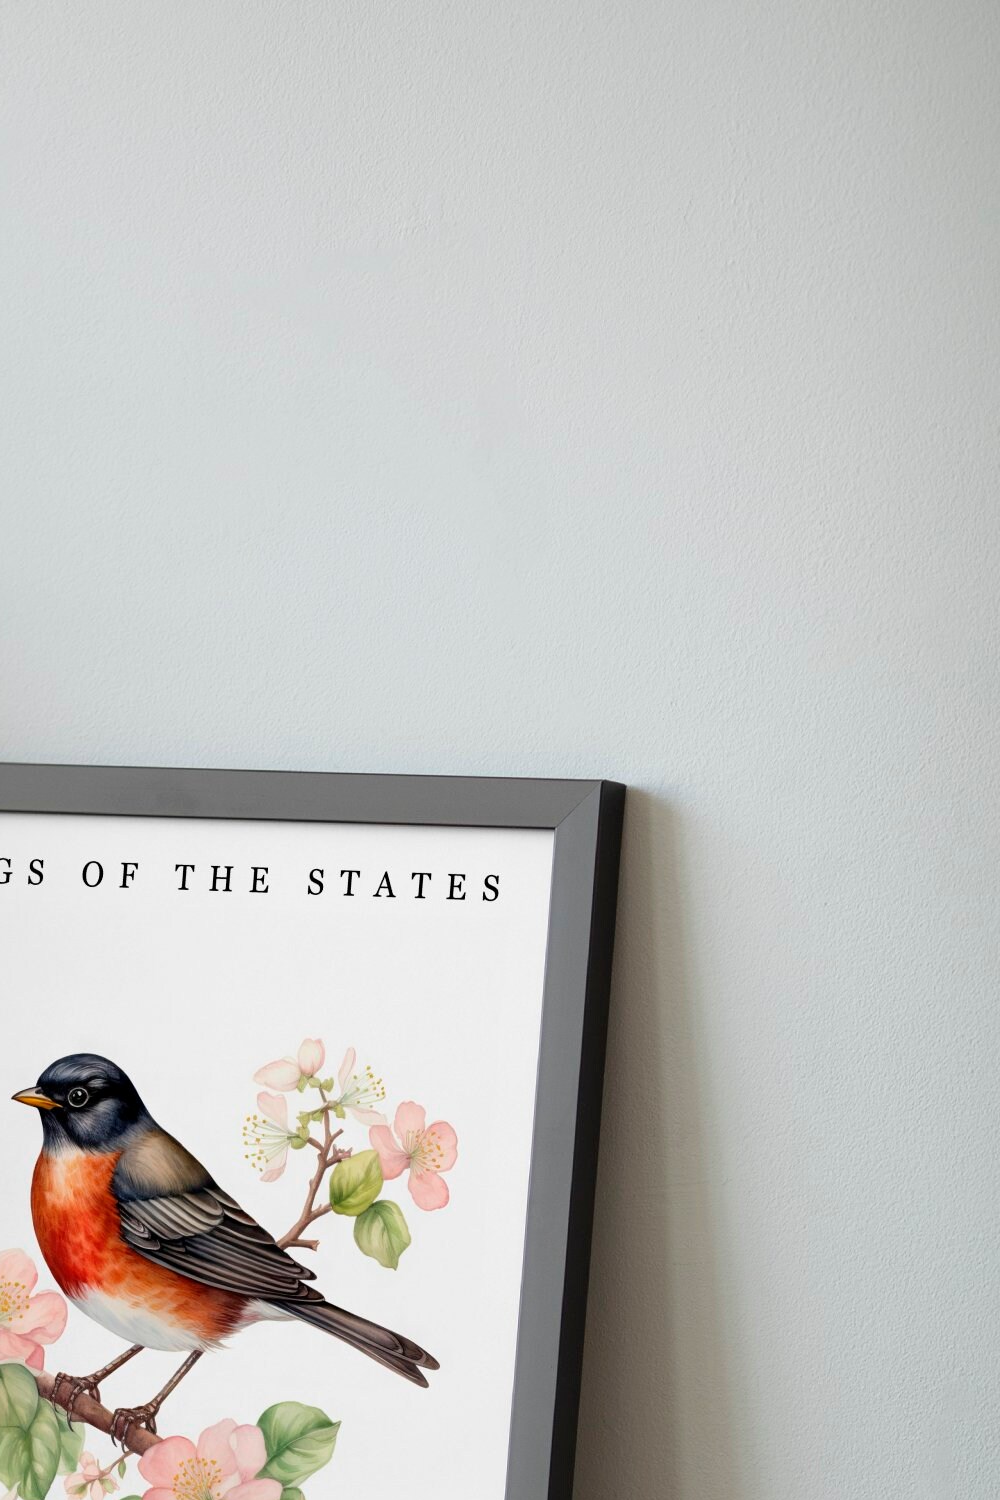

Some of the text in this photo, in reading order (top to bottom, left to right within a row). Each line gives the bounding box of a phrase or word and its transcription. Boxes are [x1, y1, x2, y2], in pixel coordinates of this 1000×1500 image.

[81, 860, 139, 889] OF
[174, 863, 269, 894] THE
[307, 868, 501, 902] STATES
